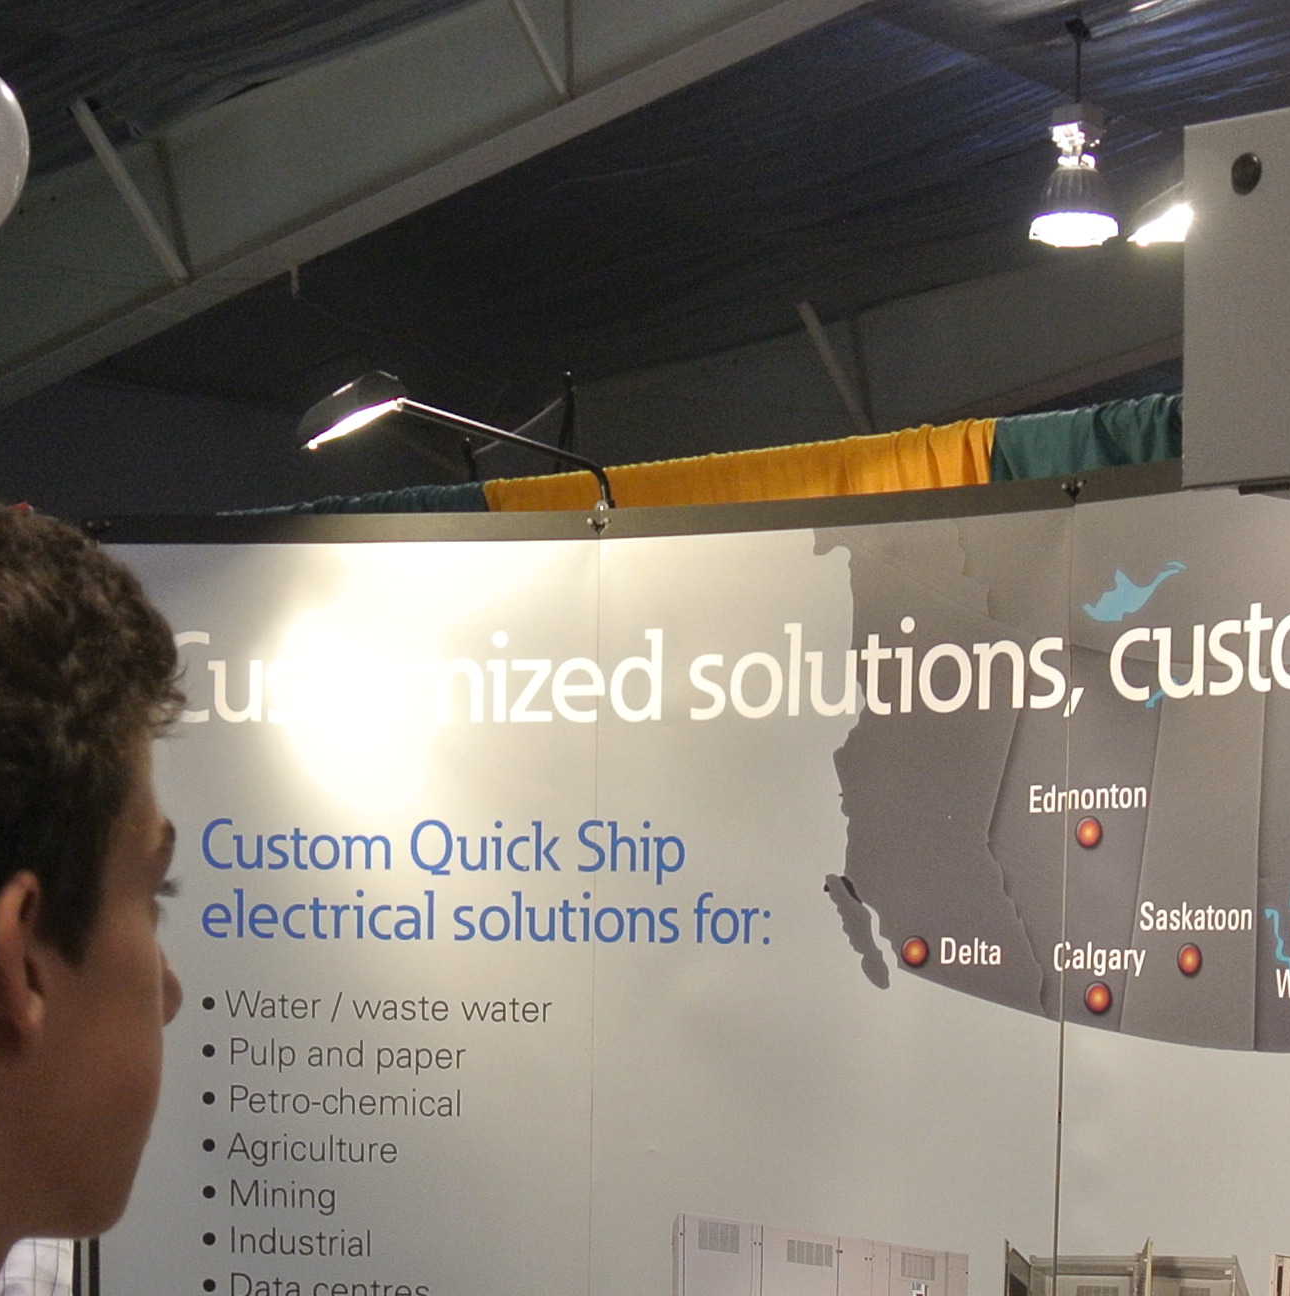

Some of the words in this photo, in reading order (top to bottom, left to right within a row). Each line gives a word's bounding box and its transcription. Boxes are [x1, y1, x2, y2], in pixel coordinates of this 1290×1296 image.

[689, 616, 1084, 721] solutions,
[1029, 783, 1148, 814] Edmonton
[201, 818, 393, 874] Custom
[409, 819, 562, 877] Quick
[577, 820, 687, 884] Ship
[201, 889, 435, 941] electrical
[453, 891, 680, 945] solutions
[693, 892, 772, 946] for:
[1139, 902, 1253, 932] Saskatoon
[939, 937, 1002, 965] Delta
[1053, 941, 1146, 976] Calgary
[225, 990, 322, 1020] Water
[352, 994, 450, 1022] waste
[461, 996, 552, 1024] water
[228, 1037, 296, 1073] Pulp
[307, 1039, 365, 1069] and
[375, 1045, 467, 1076] paper
[228, 1084, 463, 1117] Petro-chemical
[227, 1131, 398, 1168] Agriculture
[229, 1179, 337, 1216] Mining
[229, 1226, 372, 1258] Industrial
